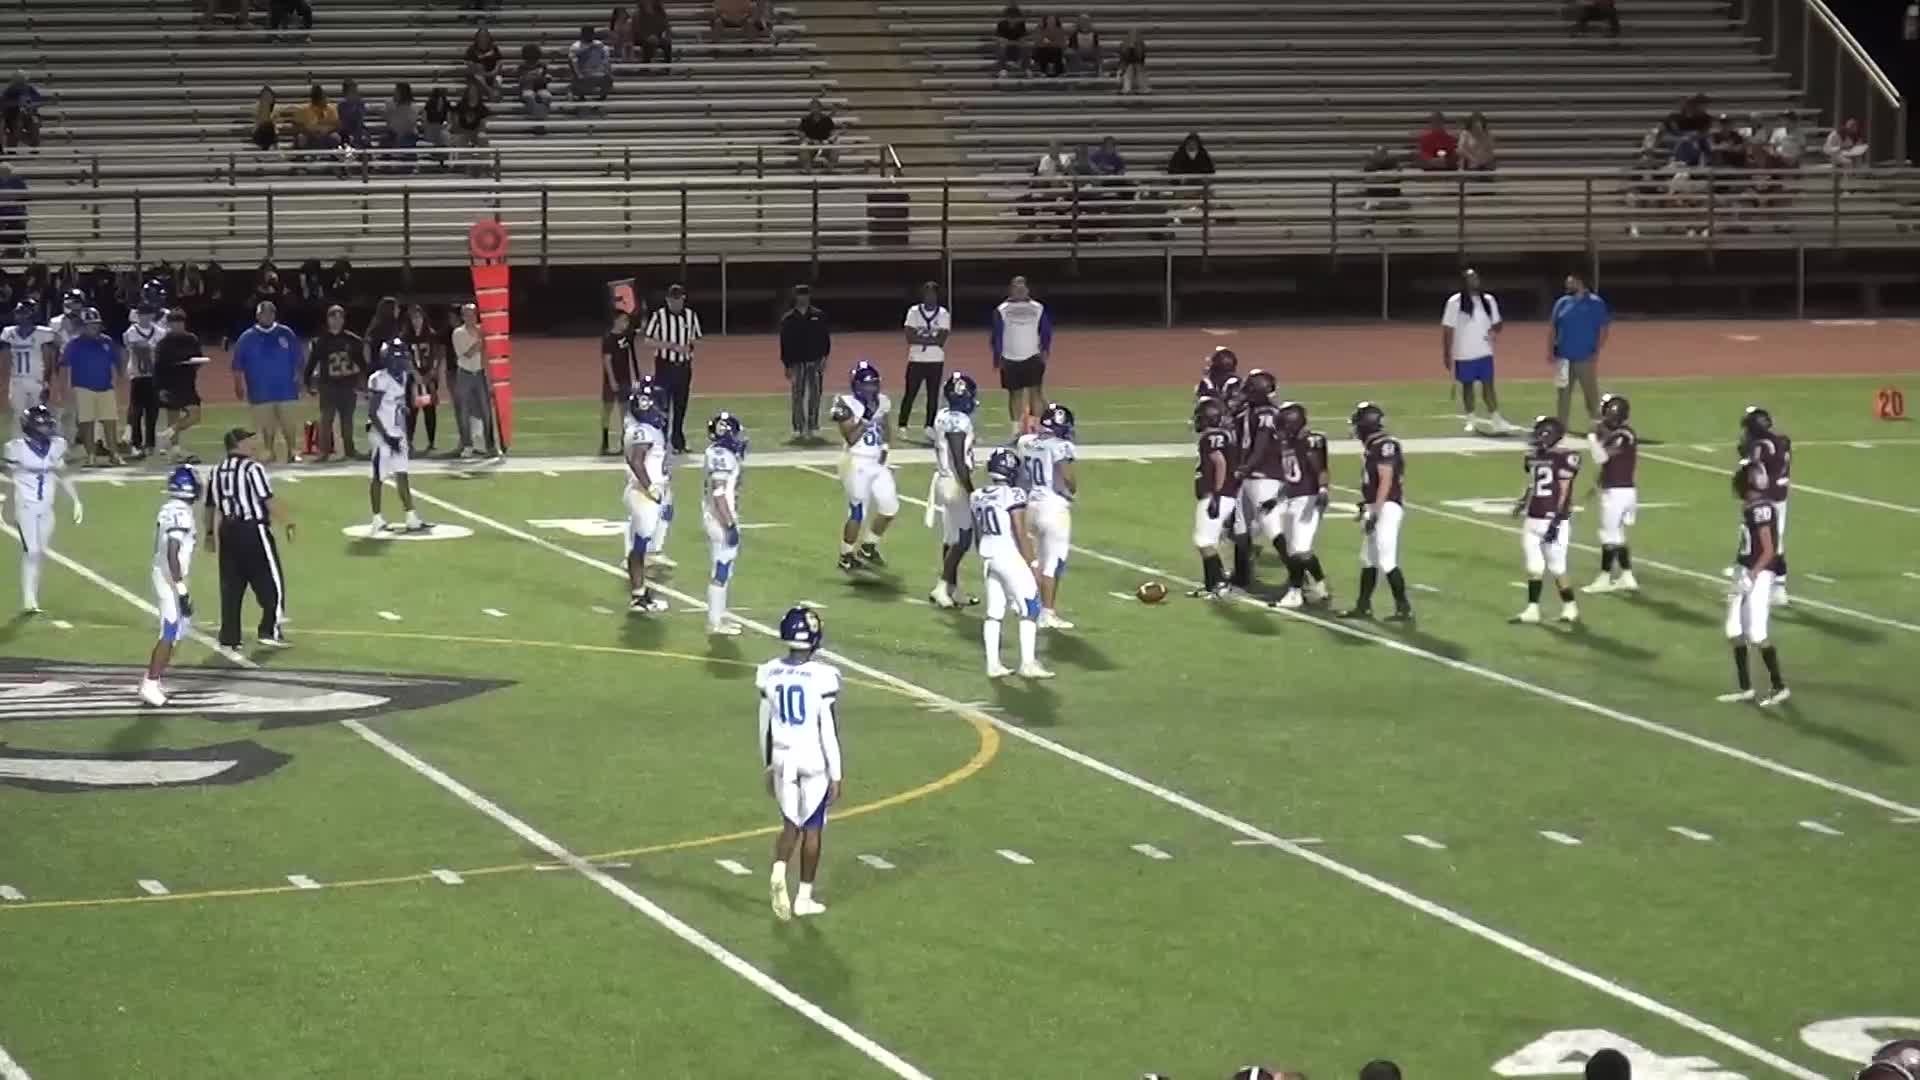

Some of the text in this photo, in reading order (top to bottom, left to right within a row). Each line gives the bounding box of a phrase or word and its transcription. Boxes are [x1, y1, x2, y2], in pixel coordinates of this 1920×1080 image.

[16, 351, 31, 373] 11
[1879, 391, 1904, 417] 20
[1023, 456, 1047, 486] 50
[36, 474, 45, 500] 1
[775, 684, 806, 725] 10
